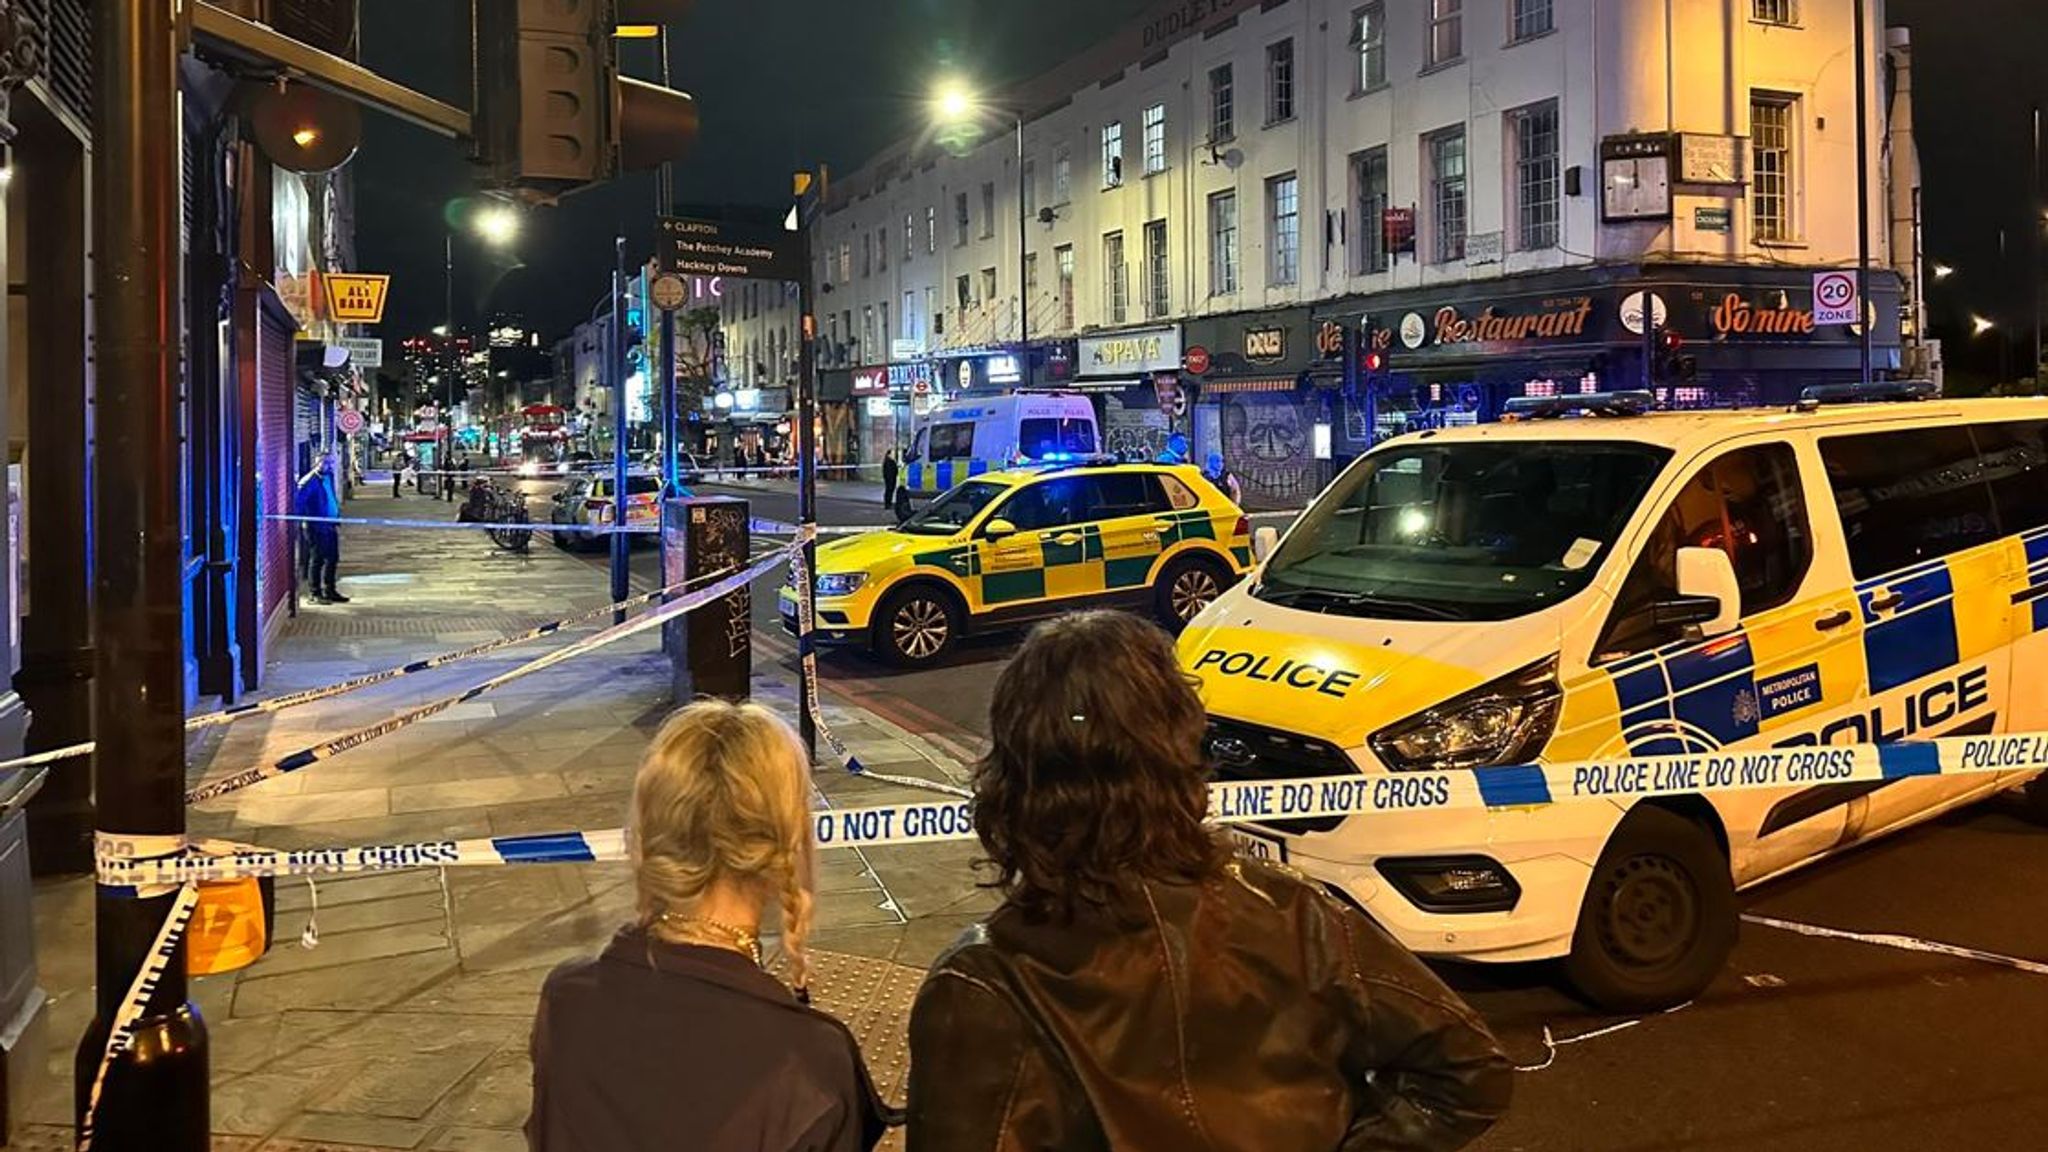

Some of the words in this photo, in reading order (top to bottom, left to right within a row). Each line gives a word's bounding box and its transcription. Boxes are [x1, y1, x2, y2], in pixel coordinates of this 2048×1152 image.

[1143, 0, 1235, 48] DUDLEY
[675, 221, 718, 234] CLAPTON
[676, 240, 695, 252] The
[696, 241, 733, 256] Petchey
[735, 246, 774, 260] Academy
[676, 259, 716, 273] Hackney
[718, 262, 749, 274] Downs
[1823, 284, 1849, 300] 20
[1434, 297, 1591, 345] Restaurant
[1818, 310, 1852, 321] ZONE
[1193, 649, 1360, 698] POLICE
[1761, 671, 1816, 696] METROPOLITAN
[1771, 687, 1811, 710] POLICE
[1772, 665, 1988, 749] OLICE
[1961, 737, 2030, 769] POLICE
[1573, 764, 1648, 796] POLICE
[1653, 759, 1700, 791] LINE
[1705, 755, 1735, 786] DO
[1740, 754, 1783, 783] NOT
[1786, 749, 1855, 781] CROSS
[1221, 785, 1273, 817] LINE
[1281, 784, 1313, 813] DO
[1320, 780, 1367, 812] NOT
[1373, 775, 1449, 809] CROSS
[843, 809, 895, 841] NOT
[902, 804, 972, 837] CROS
